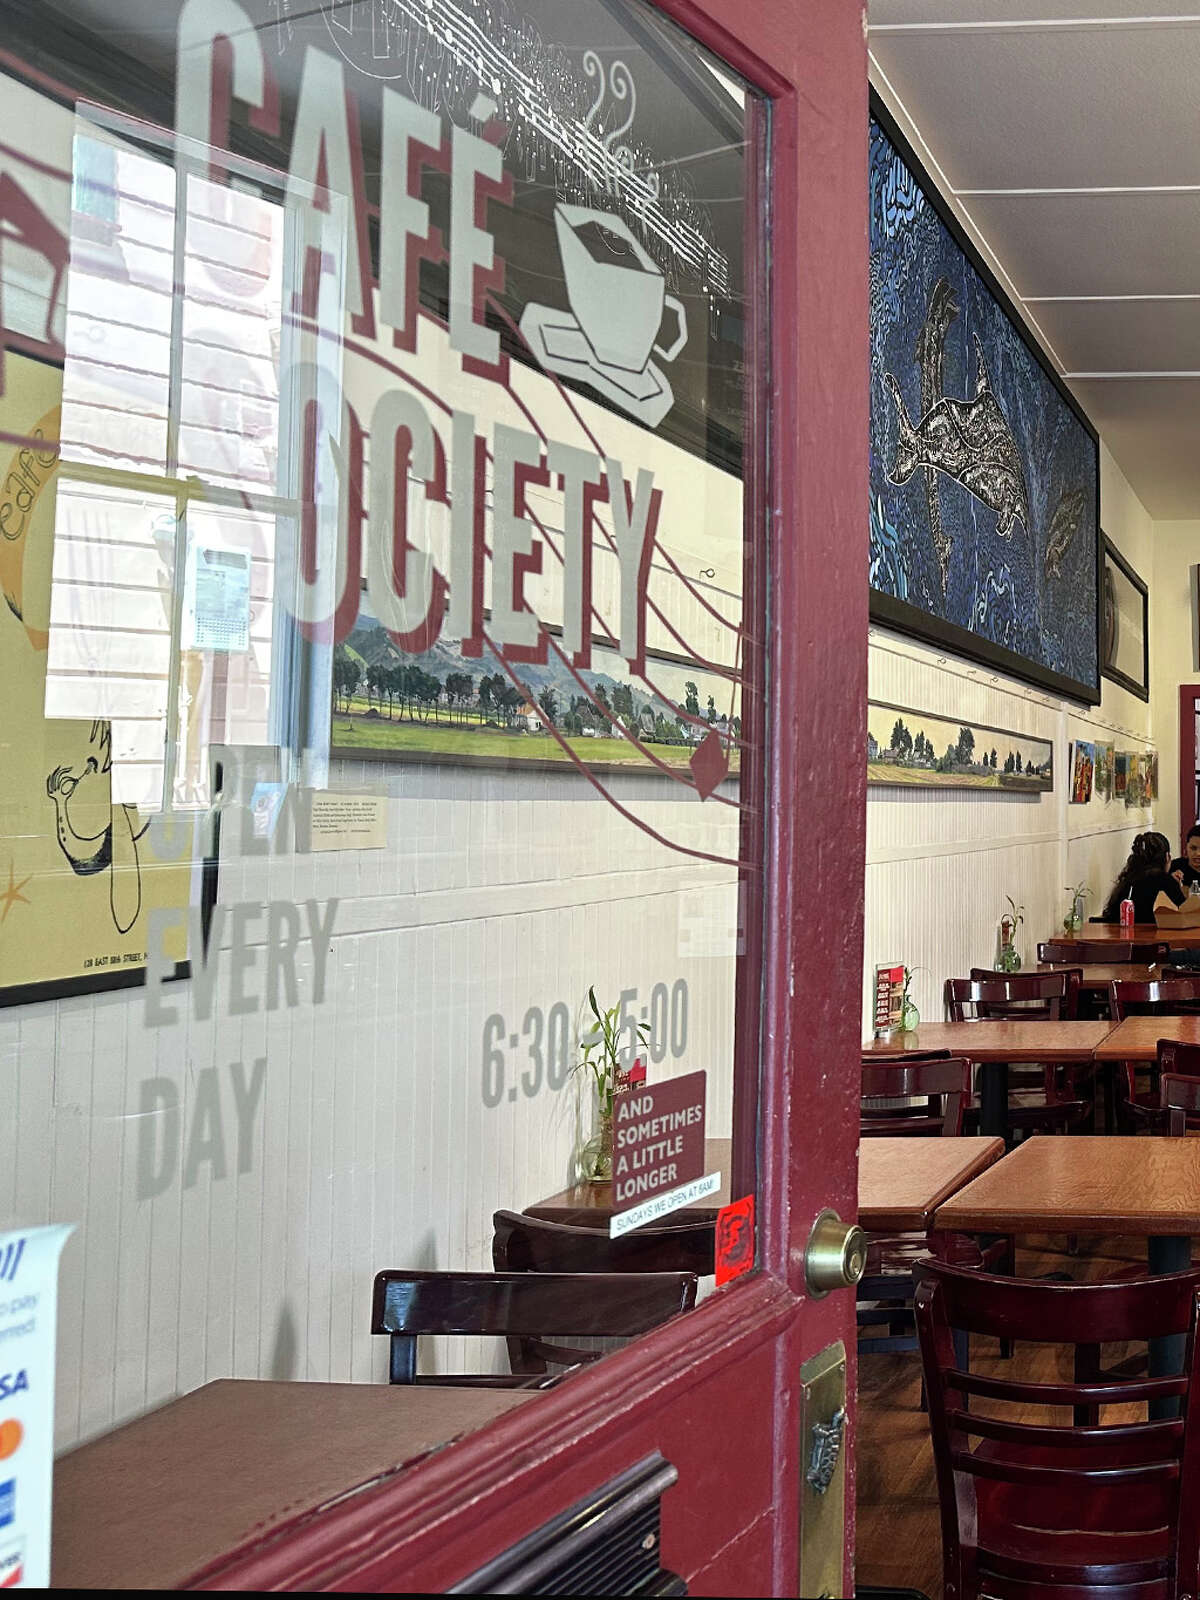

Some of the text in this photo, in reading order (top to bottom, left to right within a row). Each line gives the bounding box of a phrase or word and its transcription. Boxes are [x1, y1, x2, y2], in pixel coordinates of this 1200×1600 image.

[173, 0, 516, 384] CAFÉ
[94, 956, 109, 967] EAST
[144, 897, 340, 1030] EVERY
[481, 1001, 569, 1108] 6:30
[619, 978, 689, 1073] 5:00
[136, 1057, 267, 1201] DAY
[617, 1095, 654, 1123] AND
[617, 1104, 703, 1149] SOMETIMES
[616, 1135, 684, 1176] A LITTLE
[616, 1163, 678, 1202] LONGER
[616, 1204, 653, 1231] SUNDAYS
[655, 1199, 666, 1214] WE
[668, 1191, 688, 1208] OPEN
[688, 1186, 697, 1198] AT
